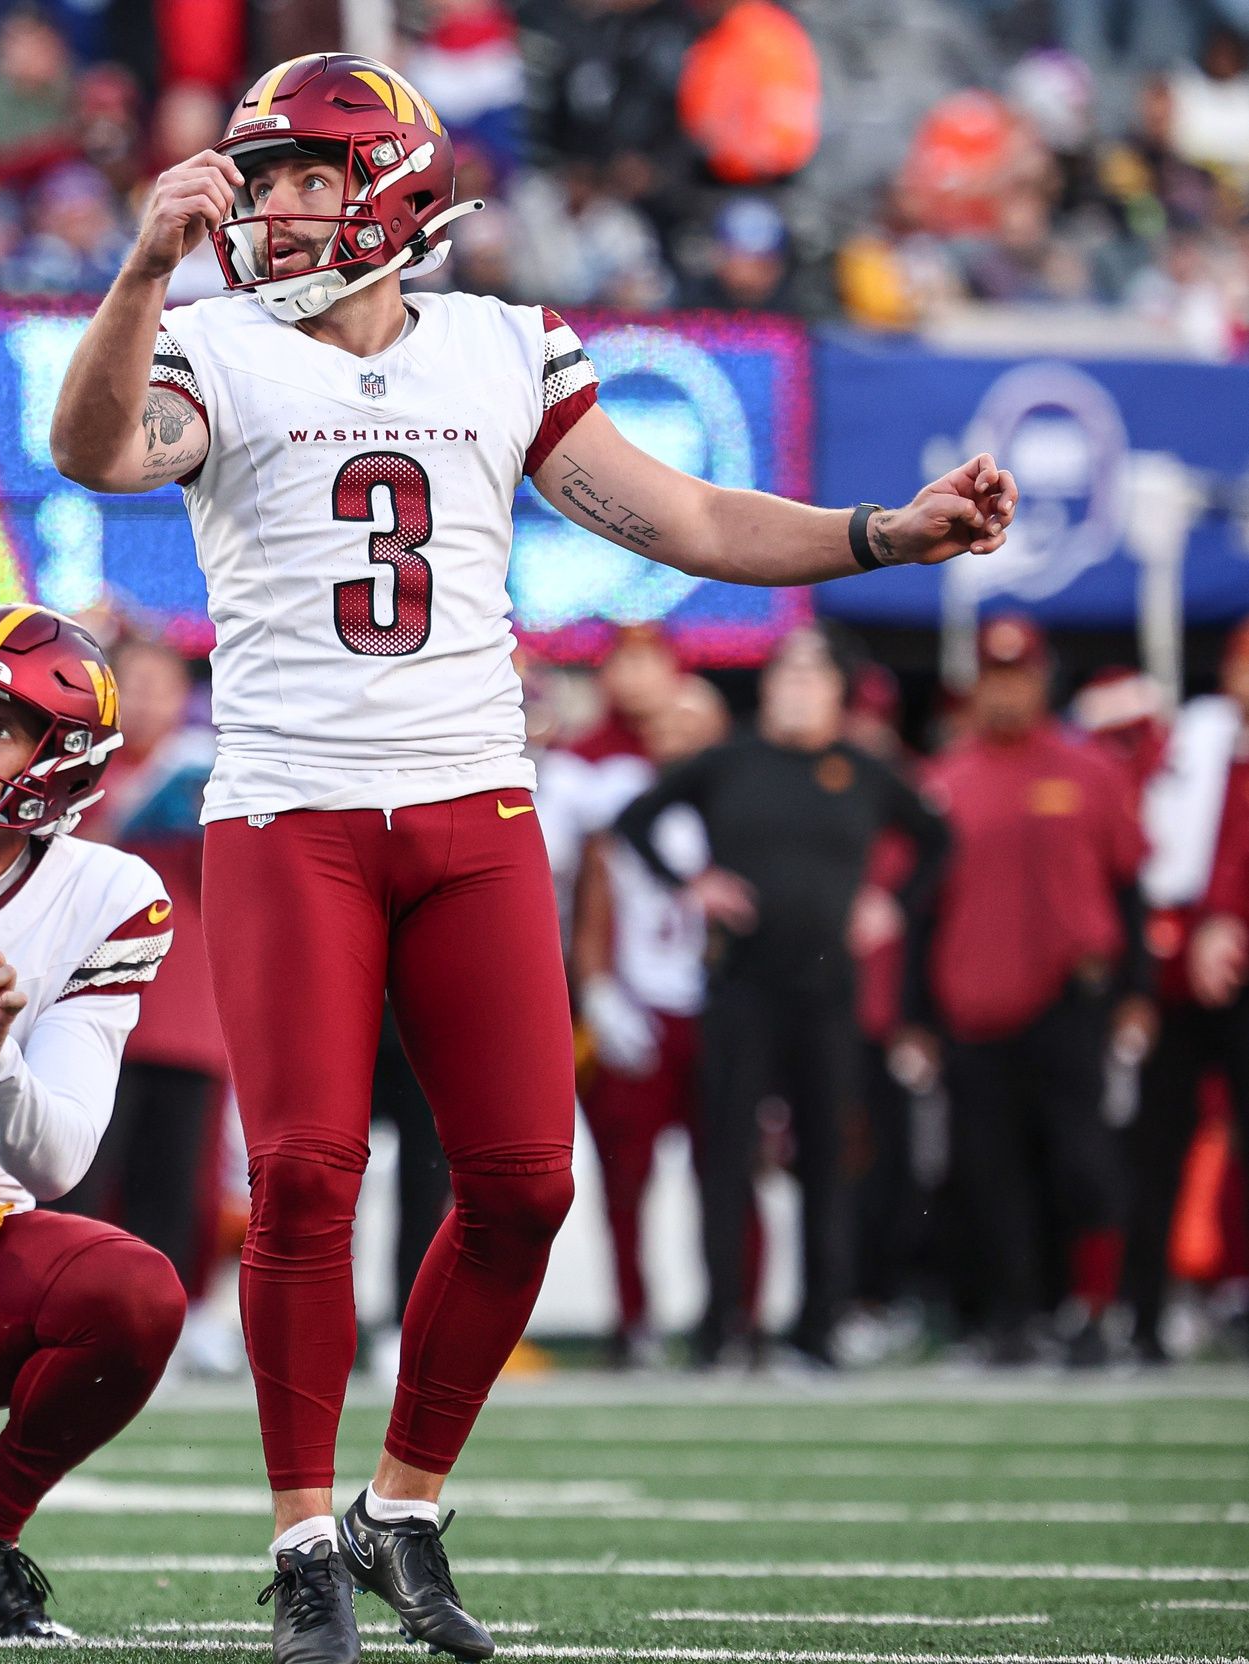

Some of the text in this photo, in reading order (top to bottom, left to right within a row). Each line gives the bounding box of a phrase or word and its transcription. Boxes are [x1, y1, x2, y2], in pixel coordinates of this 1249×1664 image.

[363, 383, 384, 395] NFL
[288, 429, 478, 442] WASHINGTON
[561, 485, 606, 524] December
[331, 450, 433, 657] 3
